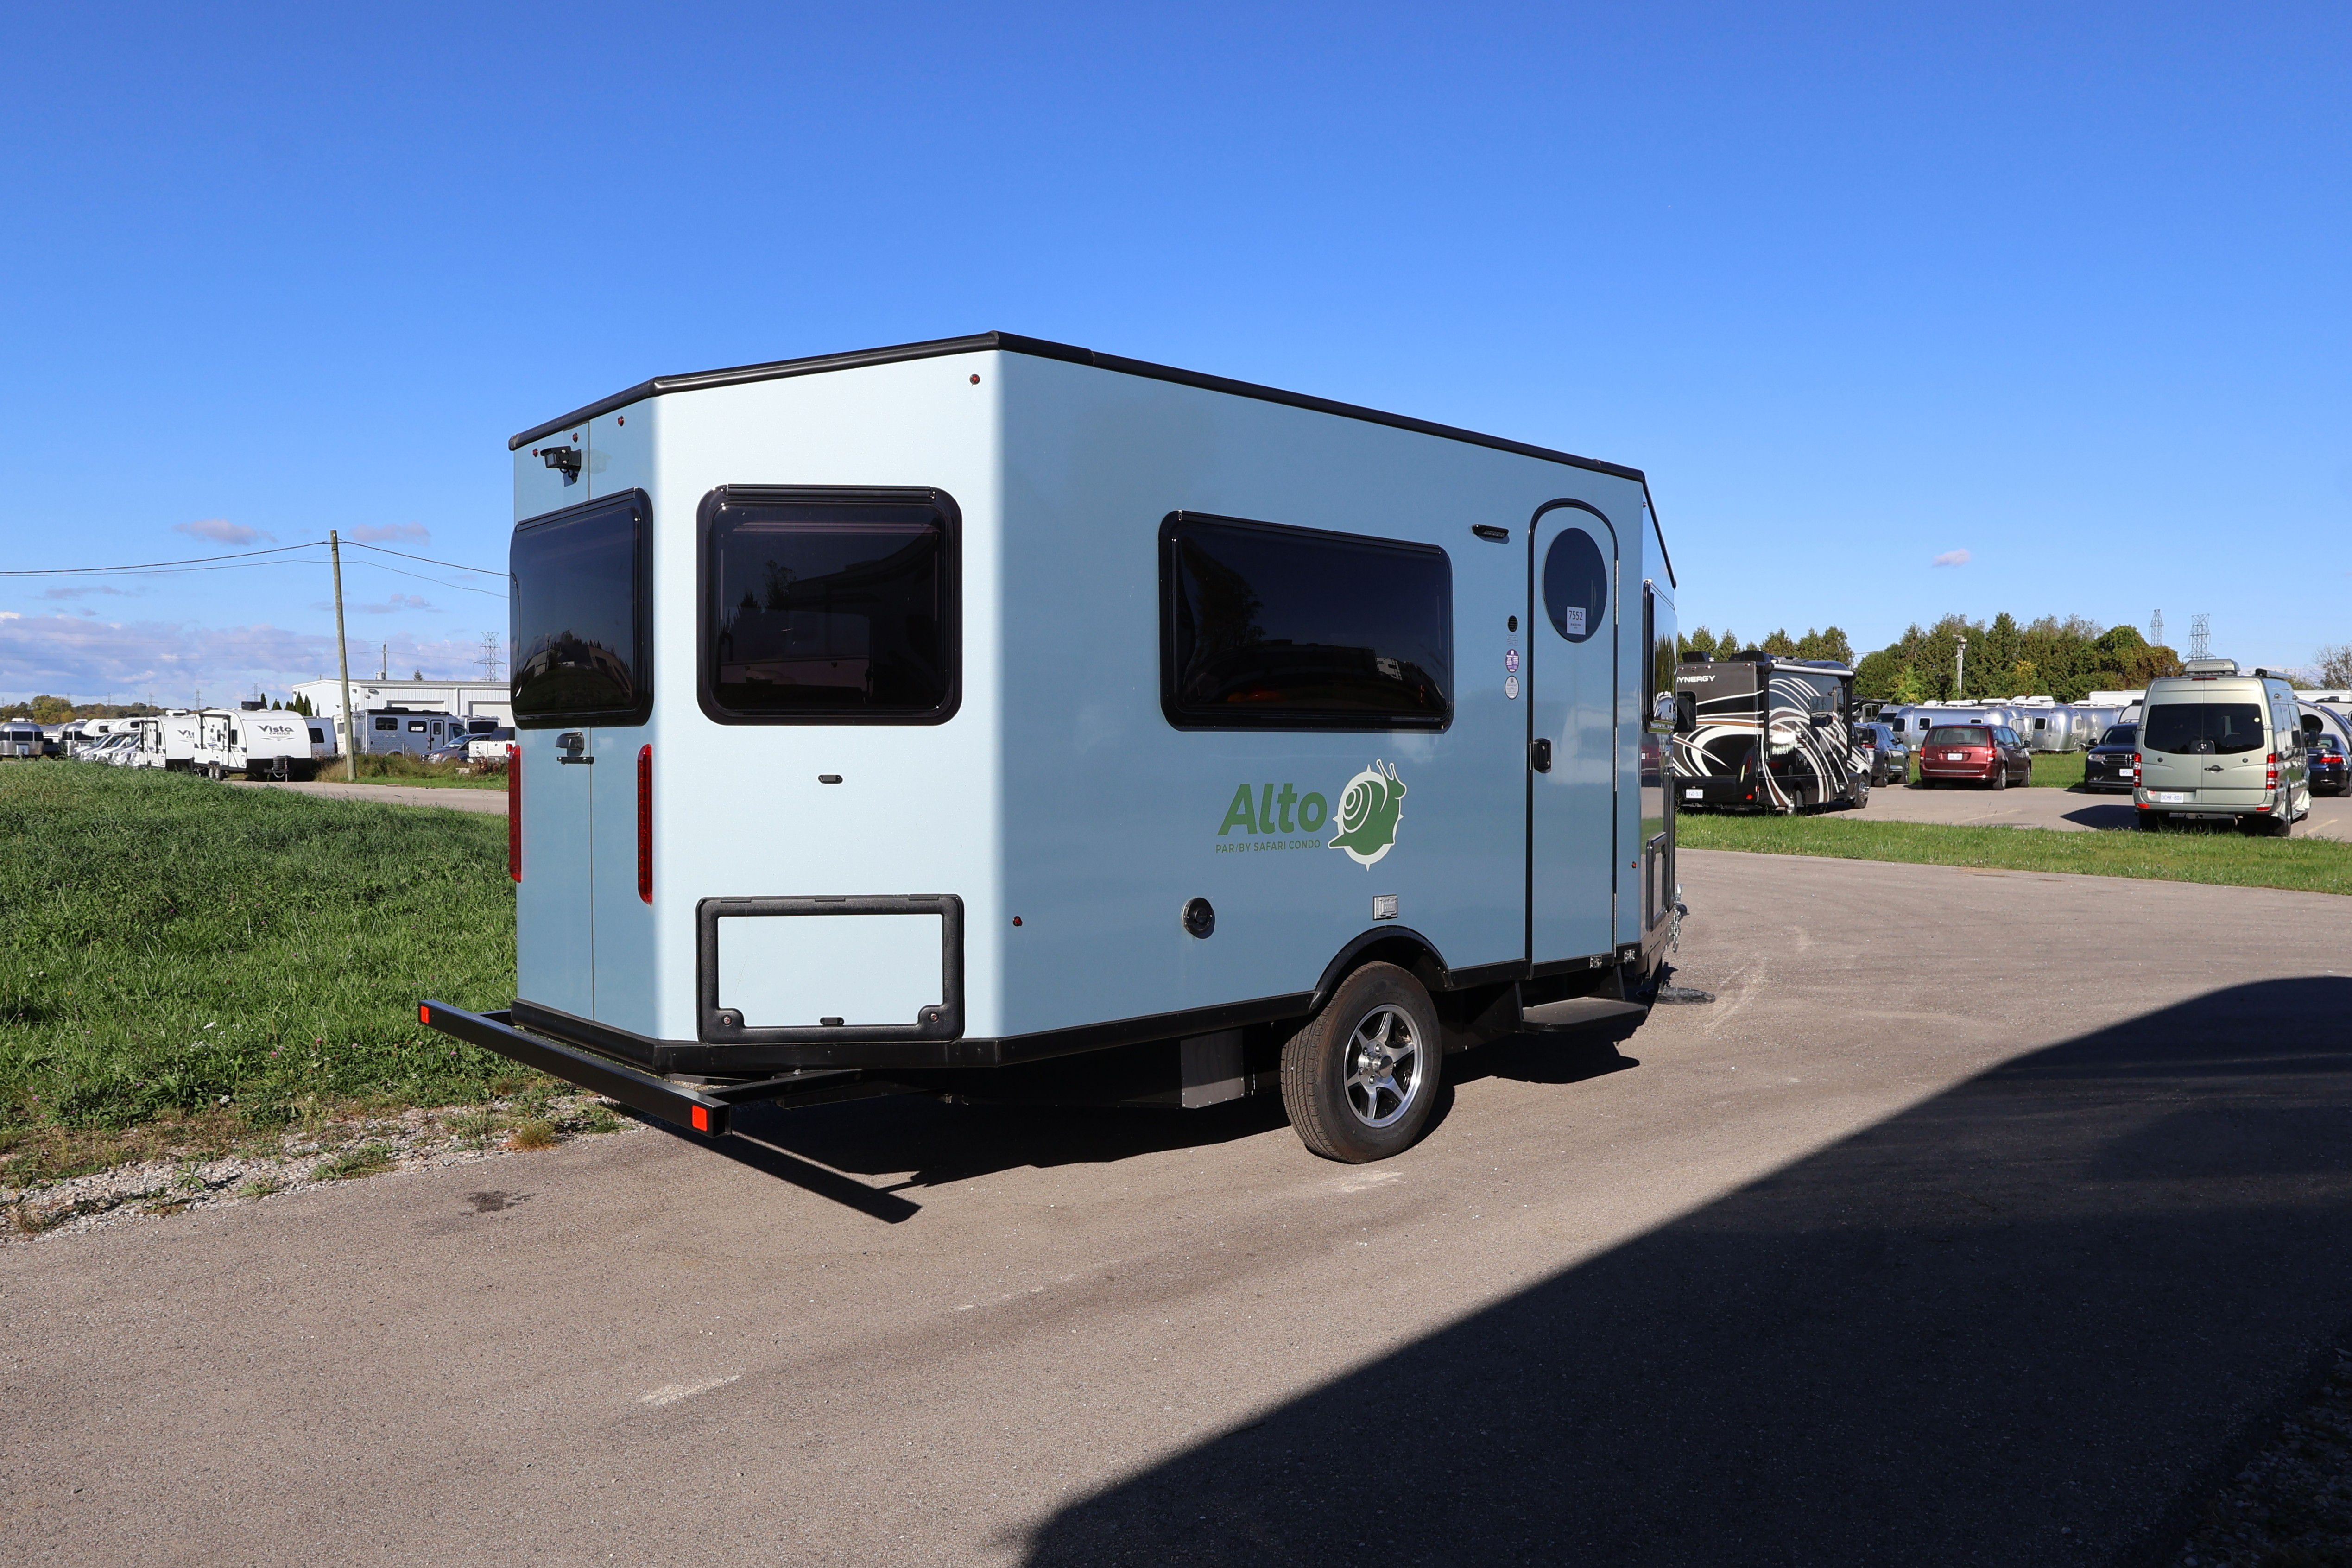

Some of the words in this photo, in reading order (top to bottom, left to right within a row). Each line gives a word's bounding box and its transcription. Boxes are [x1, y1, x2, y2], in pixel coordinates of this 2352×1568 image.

[1569, 610, 1583, 620] 7552
[1217, 783, 1327, 835] Alto
[1216, 843, 1251, 853] PAR/BY
[1253, 841, 1286, 852] SAFARI
[1289, 839, 1321, 850] CONDO
